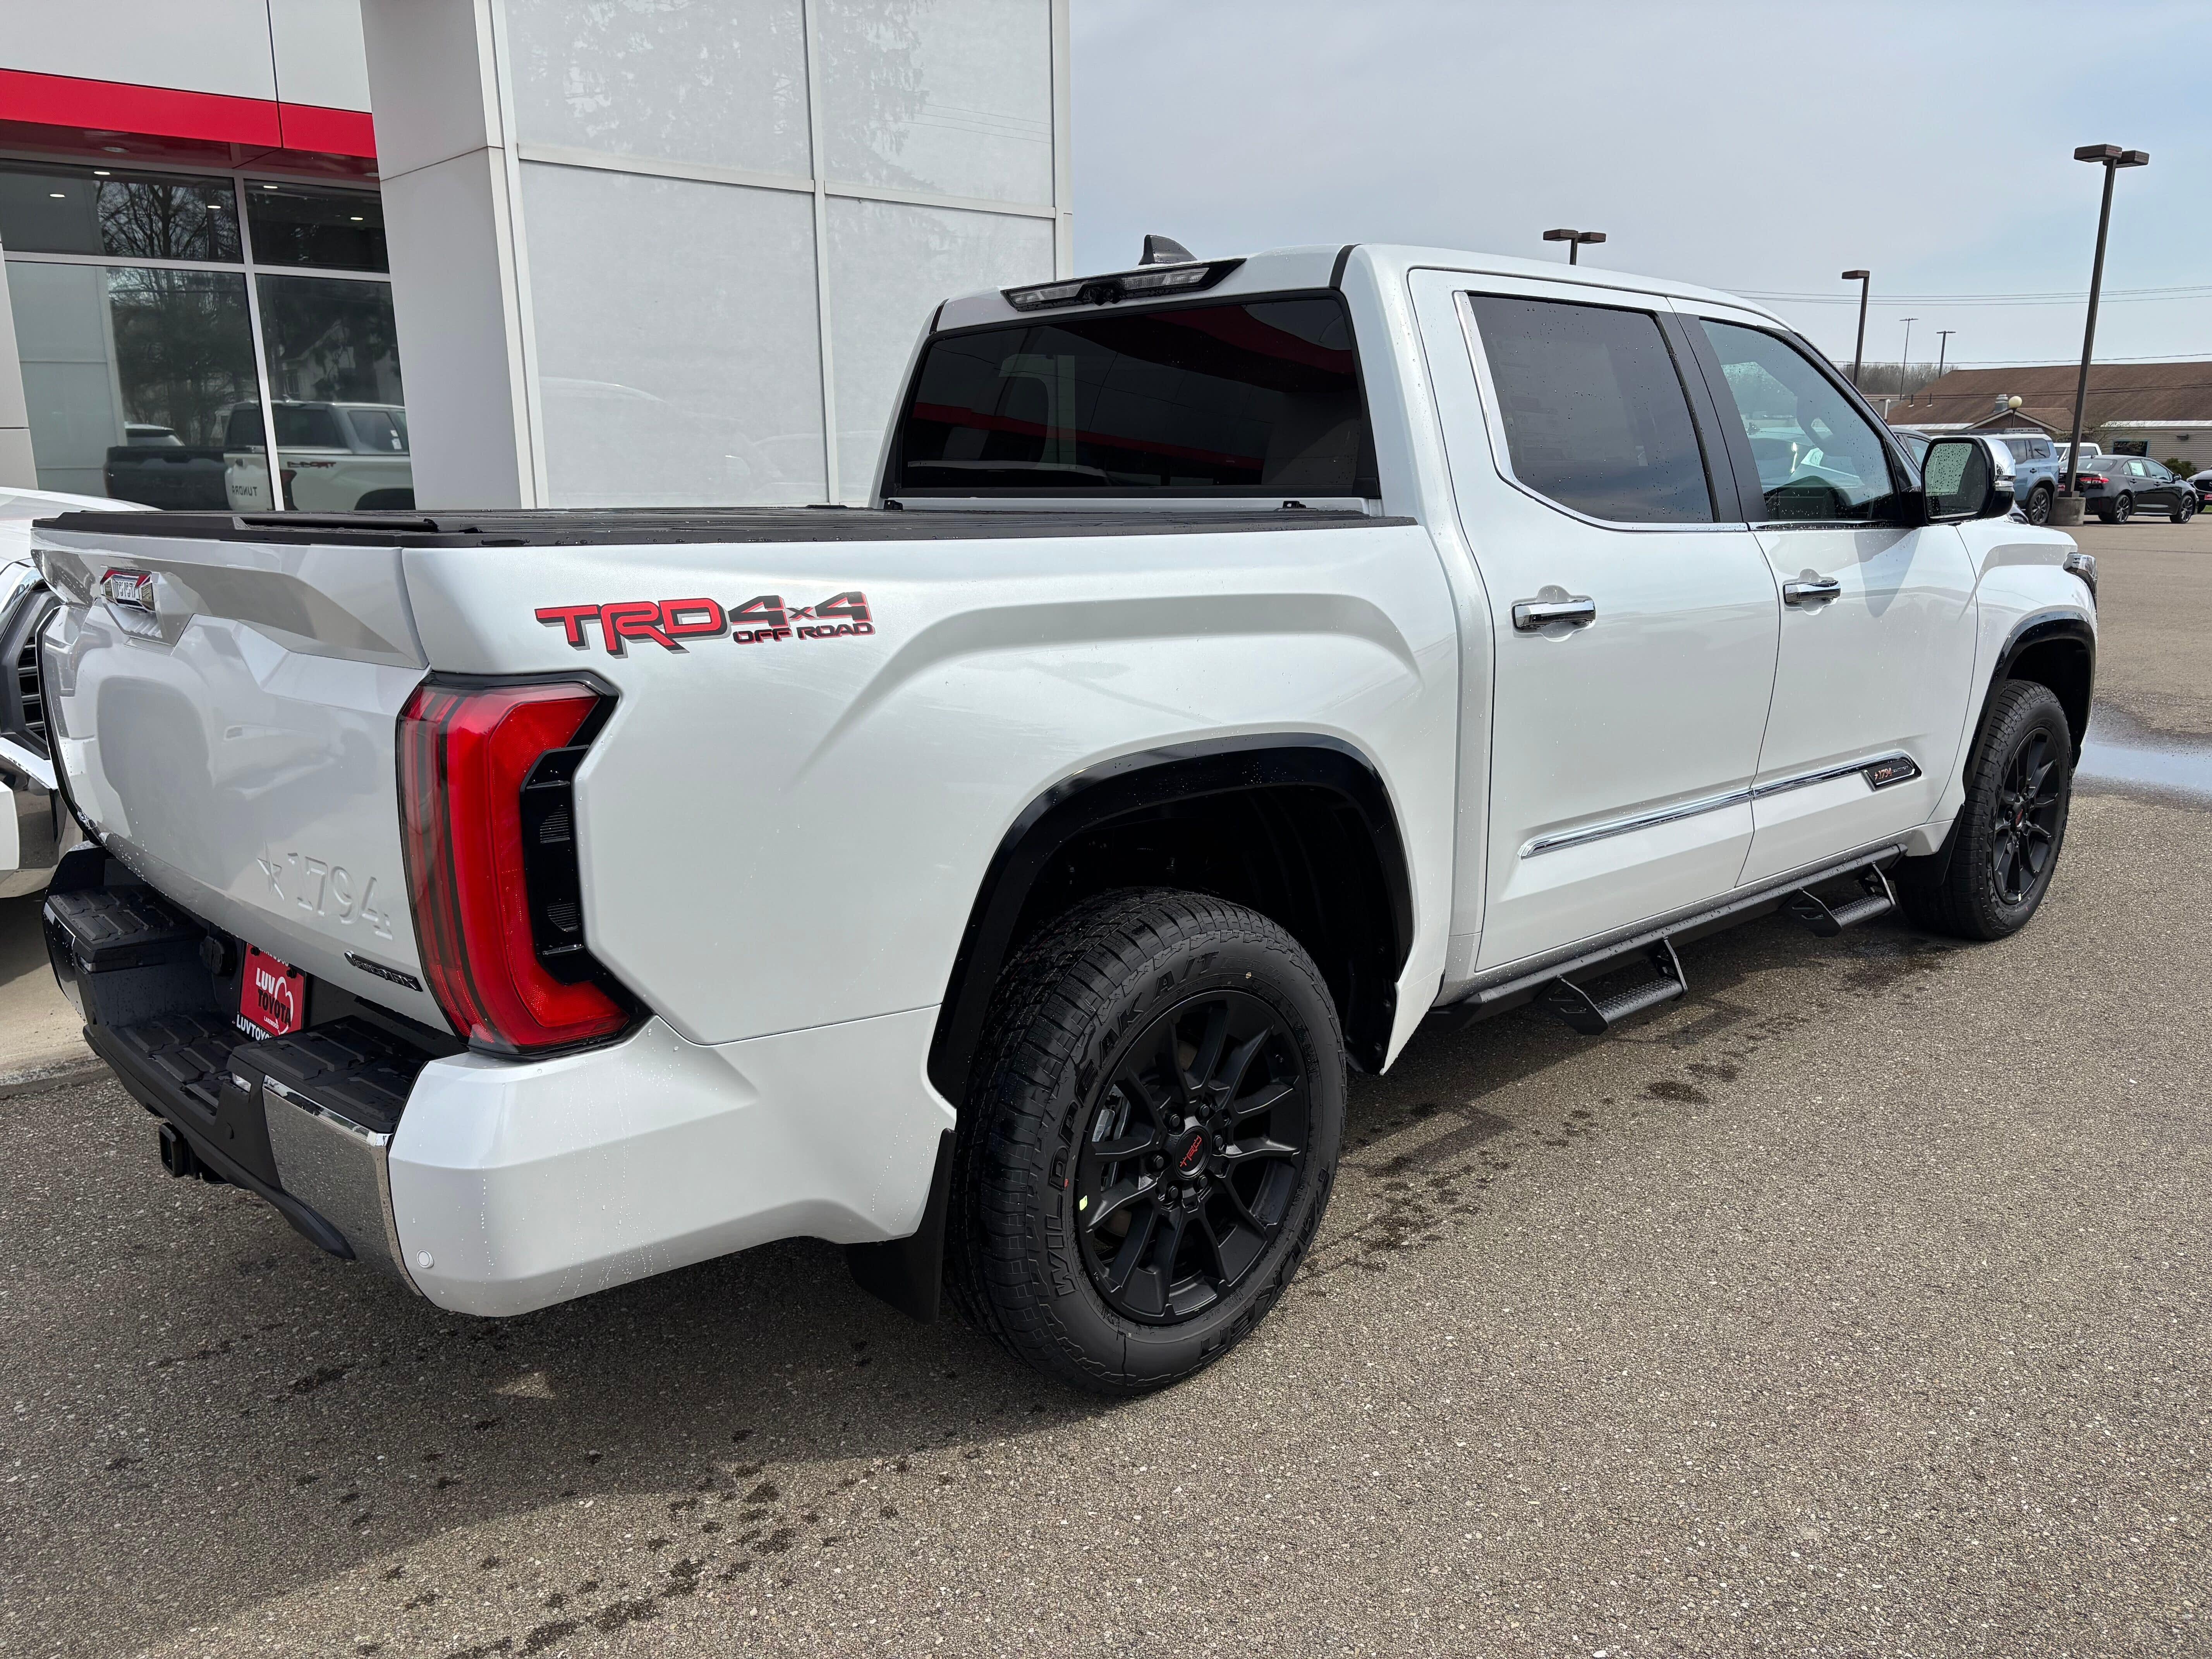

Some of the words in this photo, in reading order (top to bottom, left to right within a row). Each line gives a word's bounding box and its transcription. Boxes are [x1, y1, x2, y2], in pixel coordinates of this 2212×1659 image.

[535, 598, 731, 659] TRD
[732, 627, 793, 645] OFF
[797, 622, 876, 640] ROAD
[1878, 767, 1892, 780] 1794
[287, 852, 393, 941] 1794
[256, 967, 275, 995] LUV
[258, 989, 291, 1027] TOYOTA
[1179, 1135, 1202, 1167] TRD
